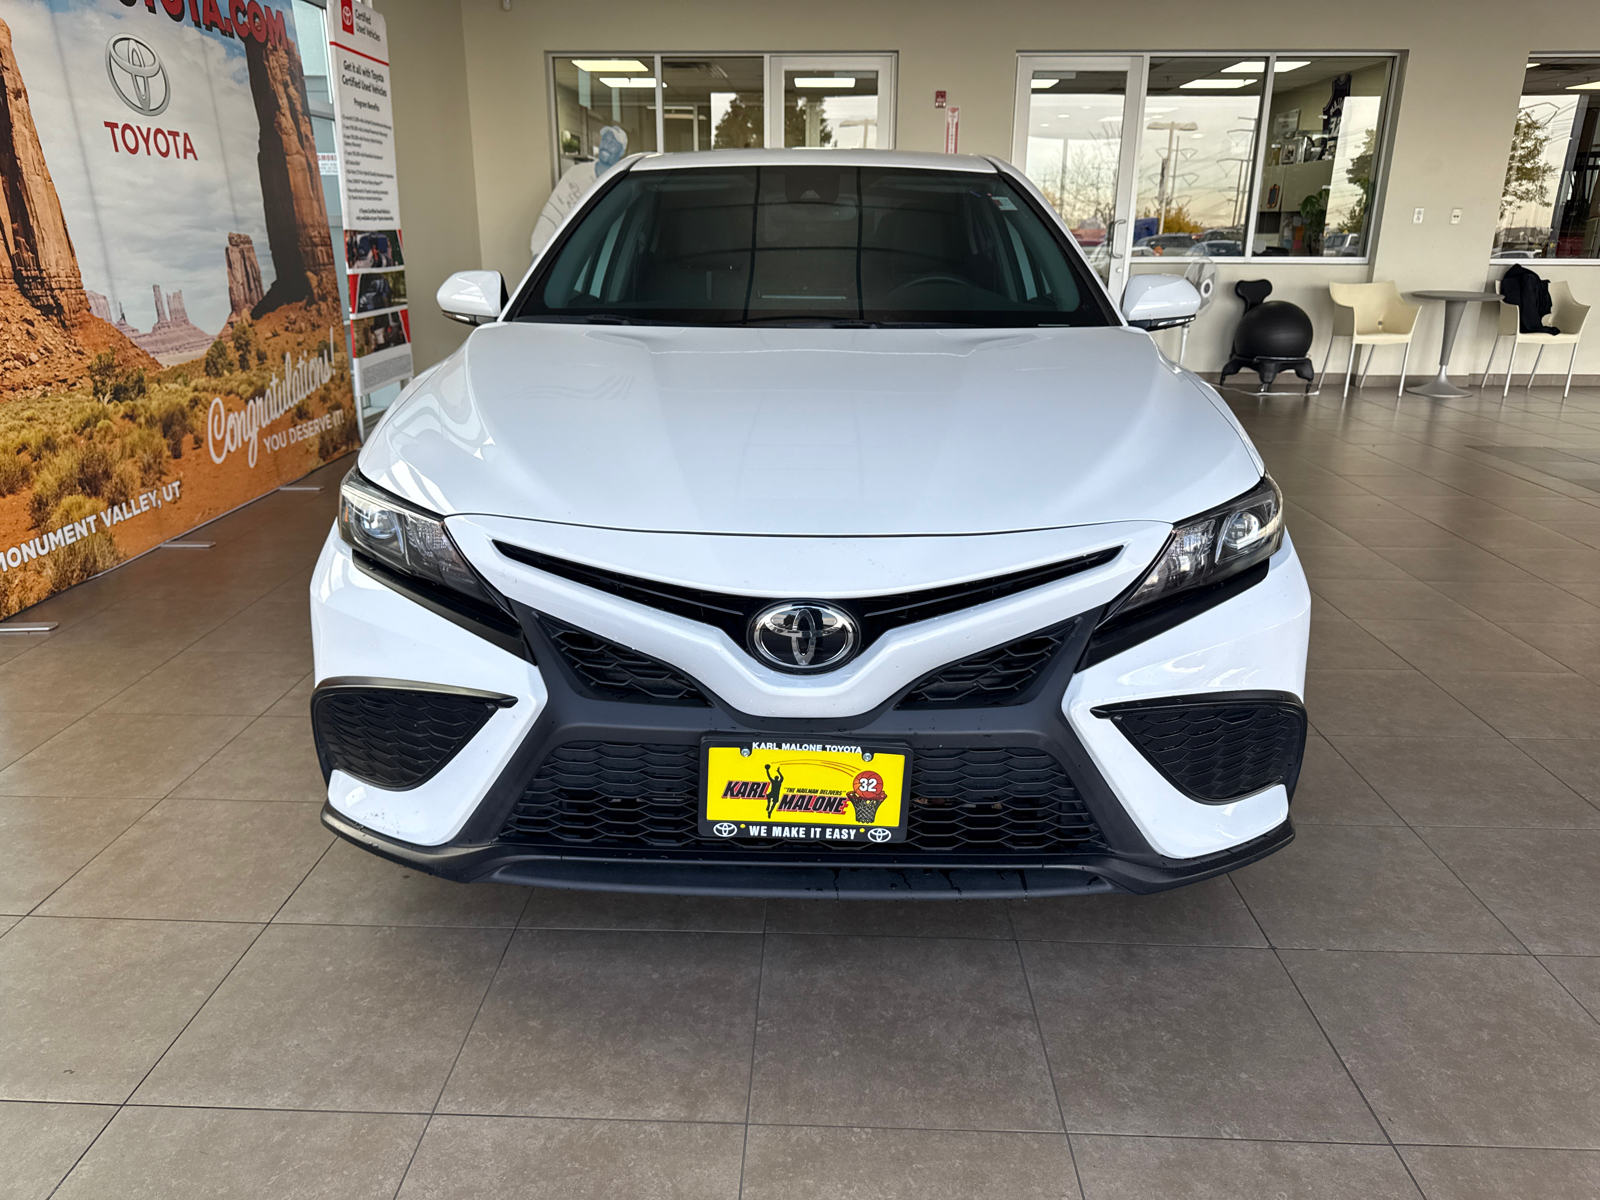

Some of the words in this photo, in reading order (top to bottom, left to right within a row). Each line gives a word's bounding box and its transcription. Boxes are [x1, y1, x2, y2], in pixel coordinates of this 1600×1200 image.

[354, 8, 371, 25] Certified
[355, 21, 366, 35] Used
[366, 27, 381, 42] Vehicles
[342, 59, 352, 72] Get
[361, 67, 371, 78] with
[370, 69, 384, 84] Toyota
[341, 74, 361, 90] Certified
[361, 79, 371, 93] Used
[371, 83, 387, 97] Vehicles
[103, 121, 198, 161] TOYOTA
[207, 327, 336, 469] Congratulations!
[263, 431, 287, 454] YOU
[288, 413, 333, 445] DESERVE
[332, 409, 346, 427] IT!
[100, 489, 162, 528] VALLEY,
[162, 480, 181, 502] UT
[752, 742, 779, 750] KARL
[781, 743, 823, 752] MALONE
[825, 744, 863, 754] TOYOTA
[721, 780, 771, 800] KARL
[859, 778, 877, 792] 32
[777, 793, 849, 815] MALONE
[749, 825, 767, 836] WE
[771, 826, 806, 838] MAKE
[810, 827, 822, 838] IT
[826, 828, 857, 840] EASY
